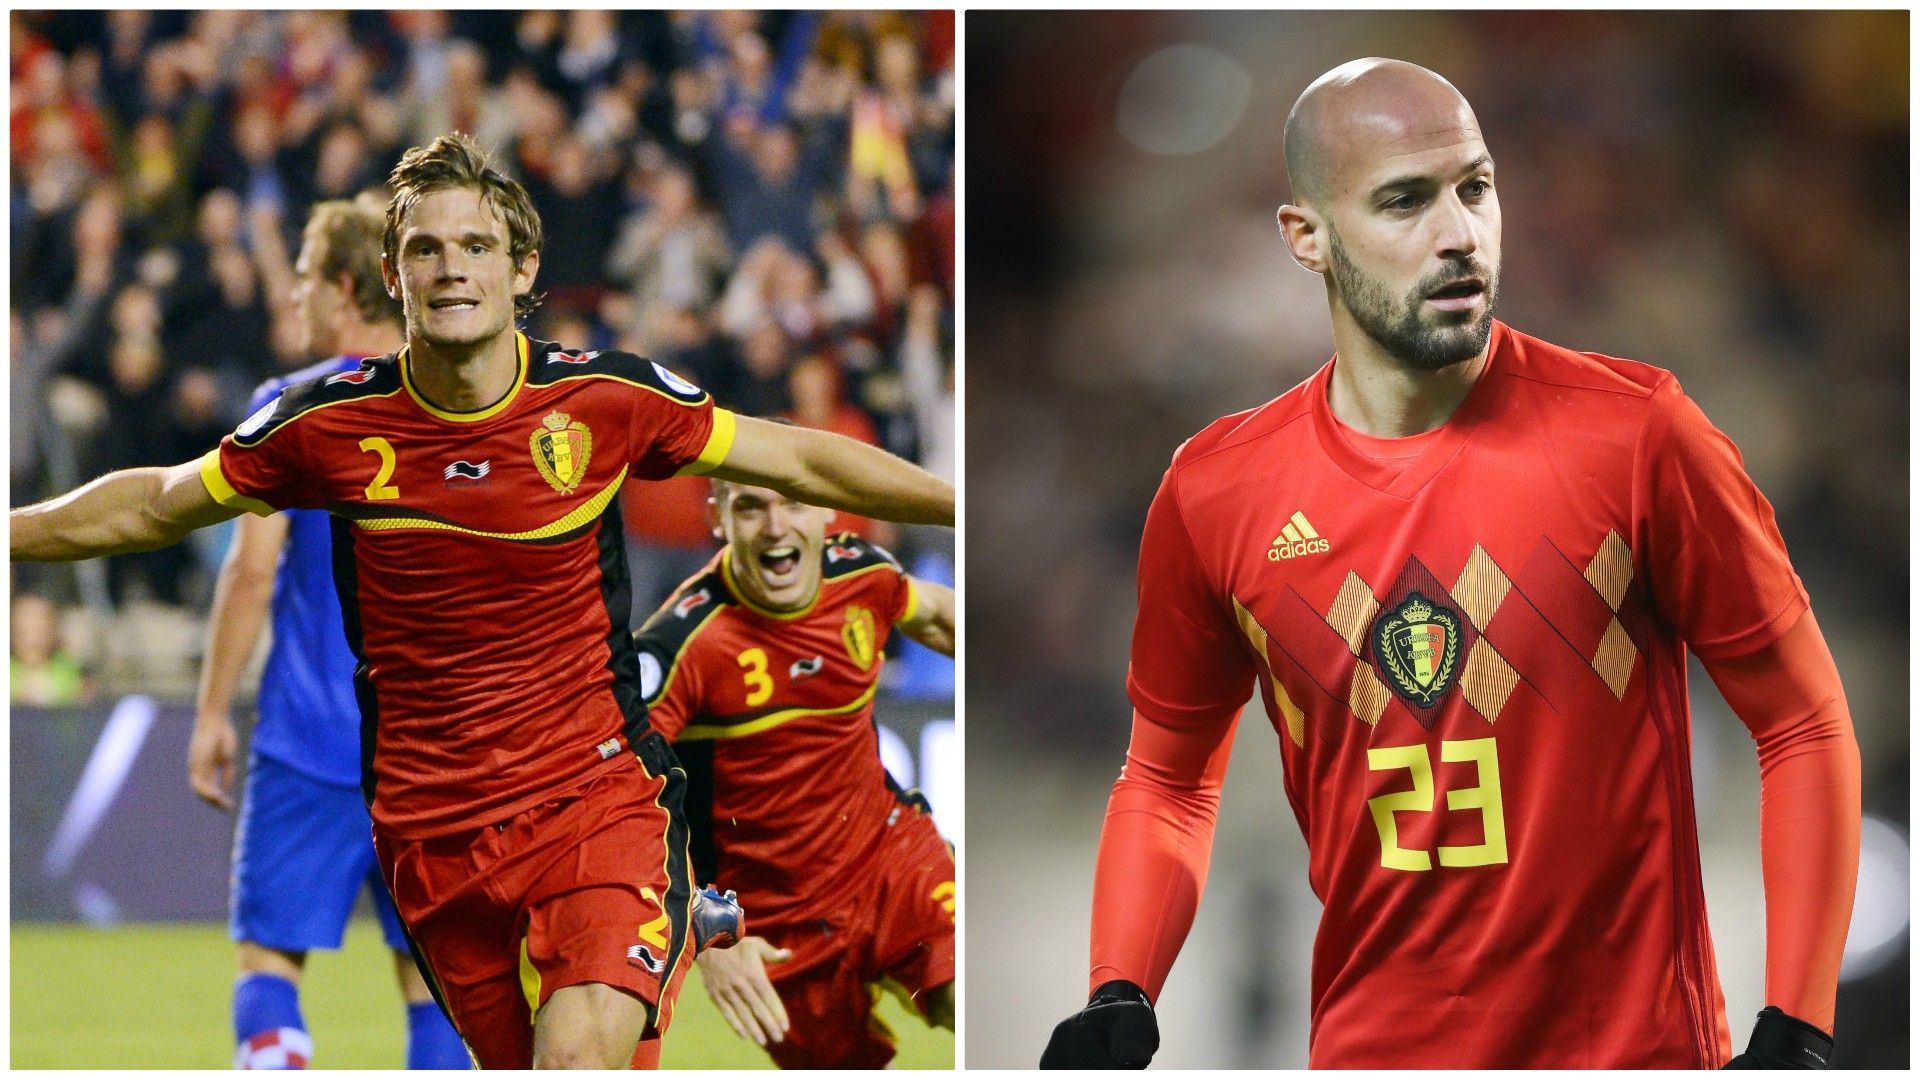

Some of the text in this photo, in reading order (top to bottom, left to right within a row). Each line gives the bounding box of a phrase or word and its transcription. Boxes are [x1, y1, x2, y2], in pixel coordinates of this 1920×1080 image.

[359, 436, 399, 500] 2
[1267, 536, 1331, 562] adidas
[737, 648, 774, 707] 3
[1367, 737, 1509, 871] 23
[638, 886, 670, 951] 2
